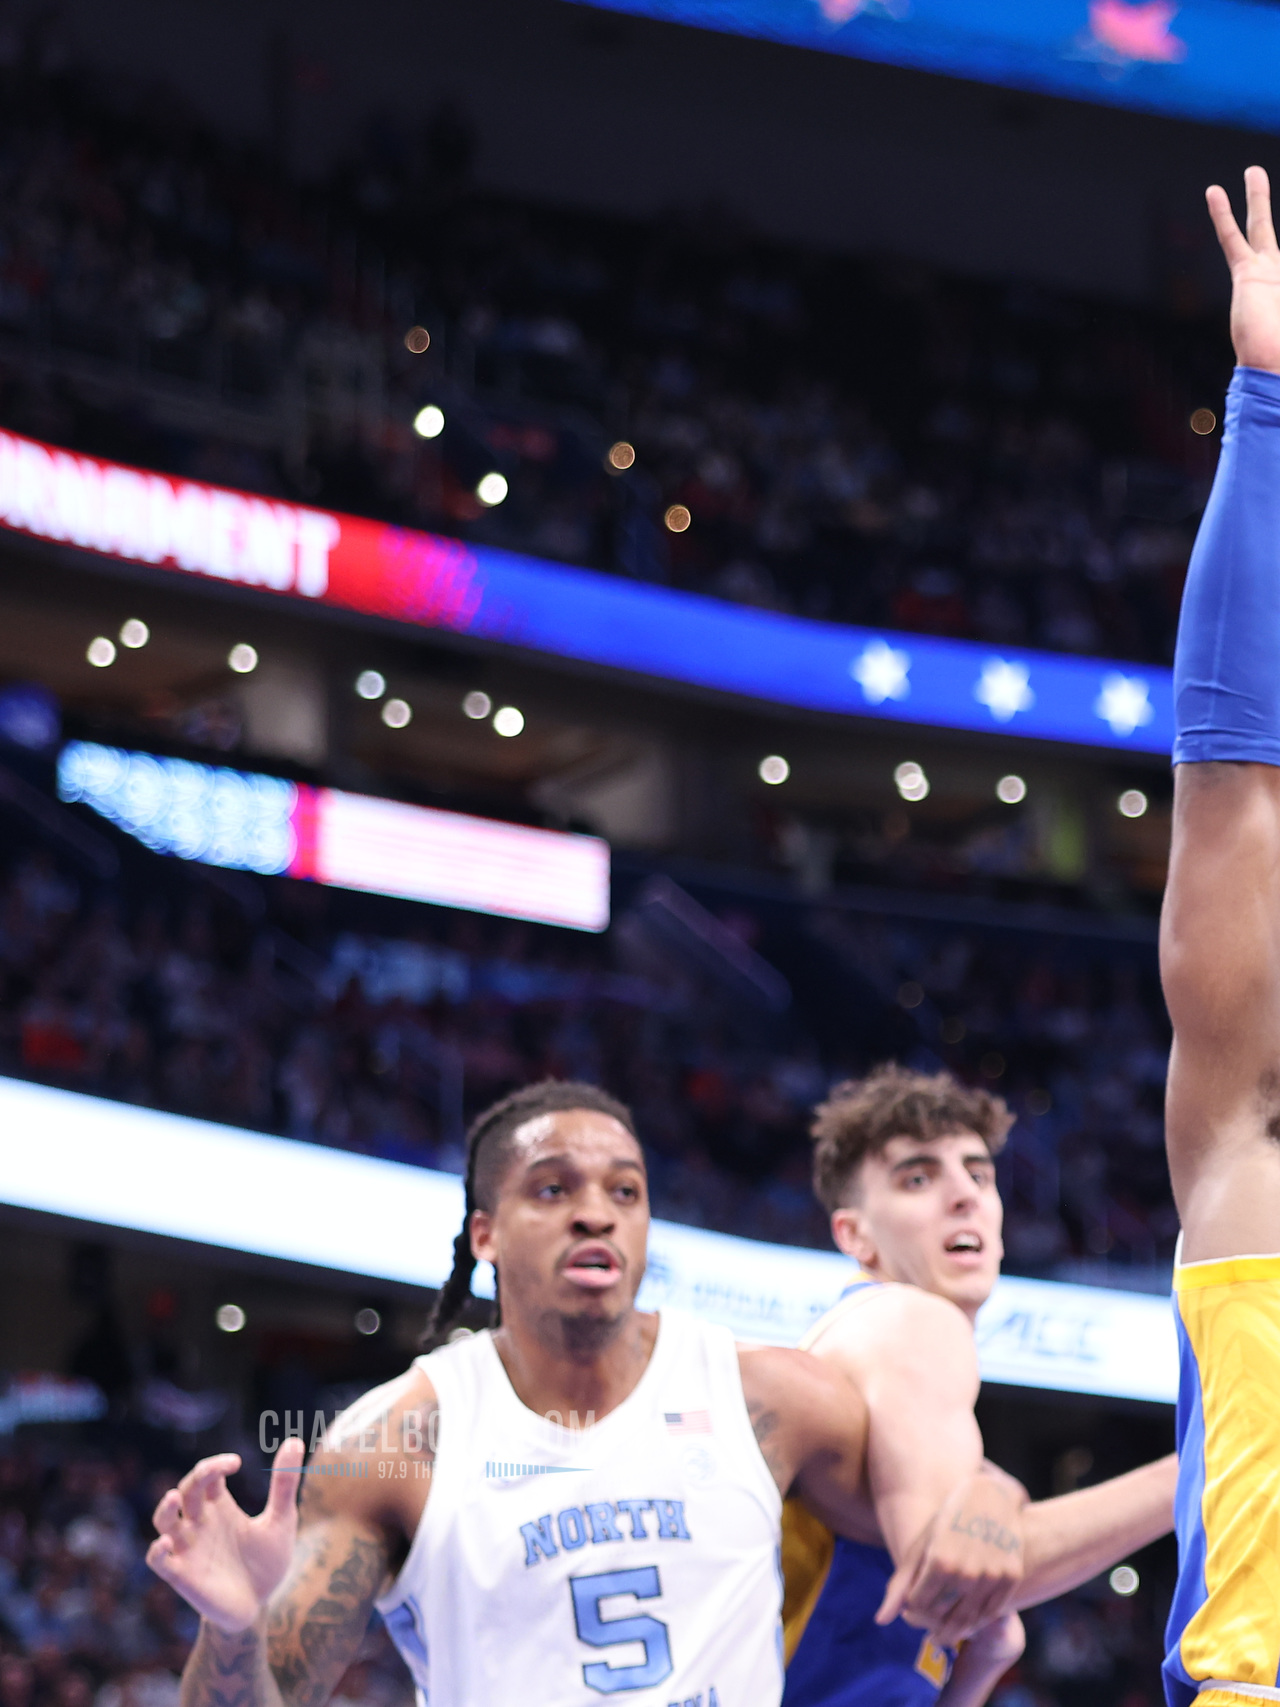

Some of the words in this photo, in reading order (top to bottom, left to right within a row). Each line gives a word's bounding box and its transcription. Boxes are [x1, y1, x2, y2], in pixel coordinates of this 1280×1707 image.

[0, 431, 341, 599] RNAMENT
[519, 1498, 692, 1567] NORTH
[568, 1565, 674, 1696] 5
